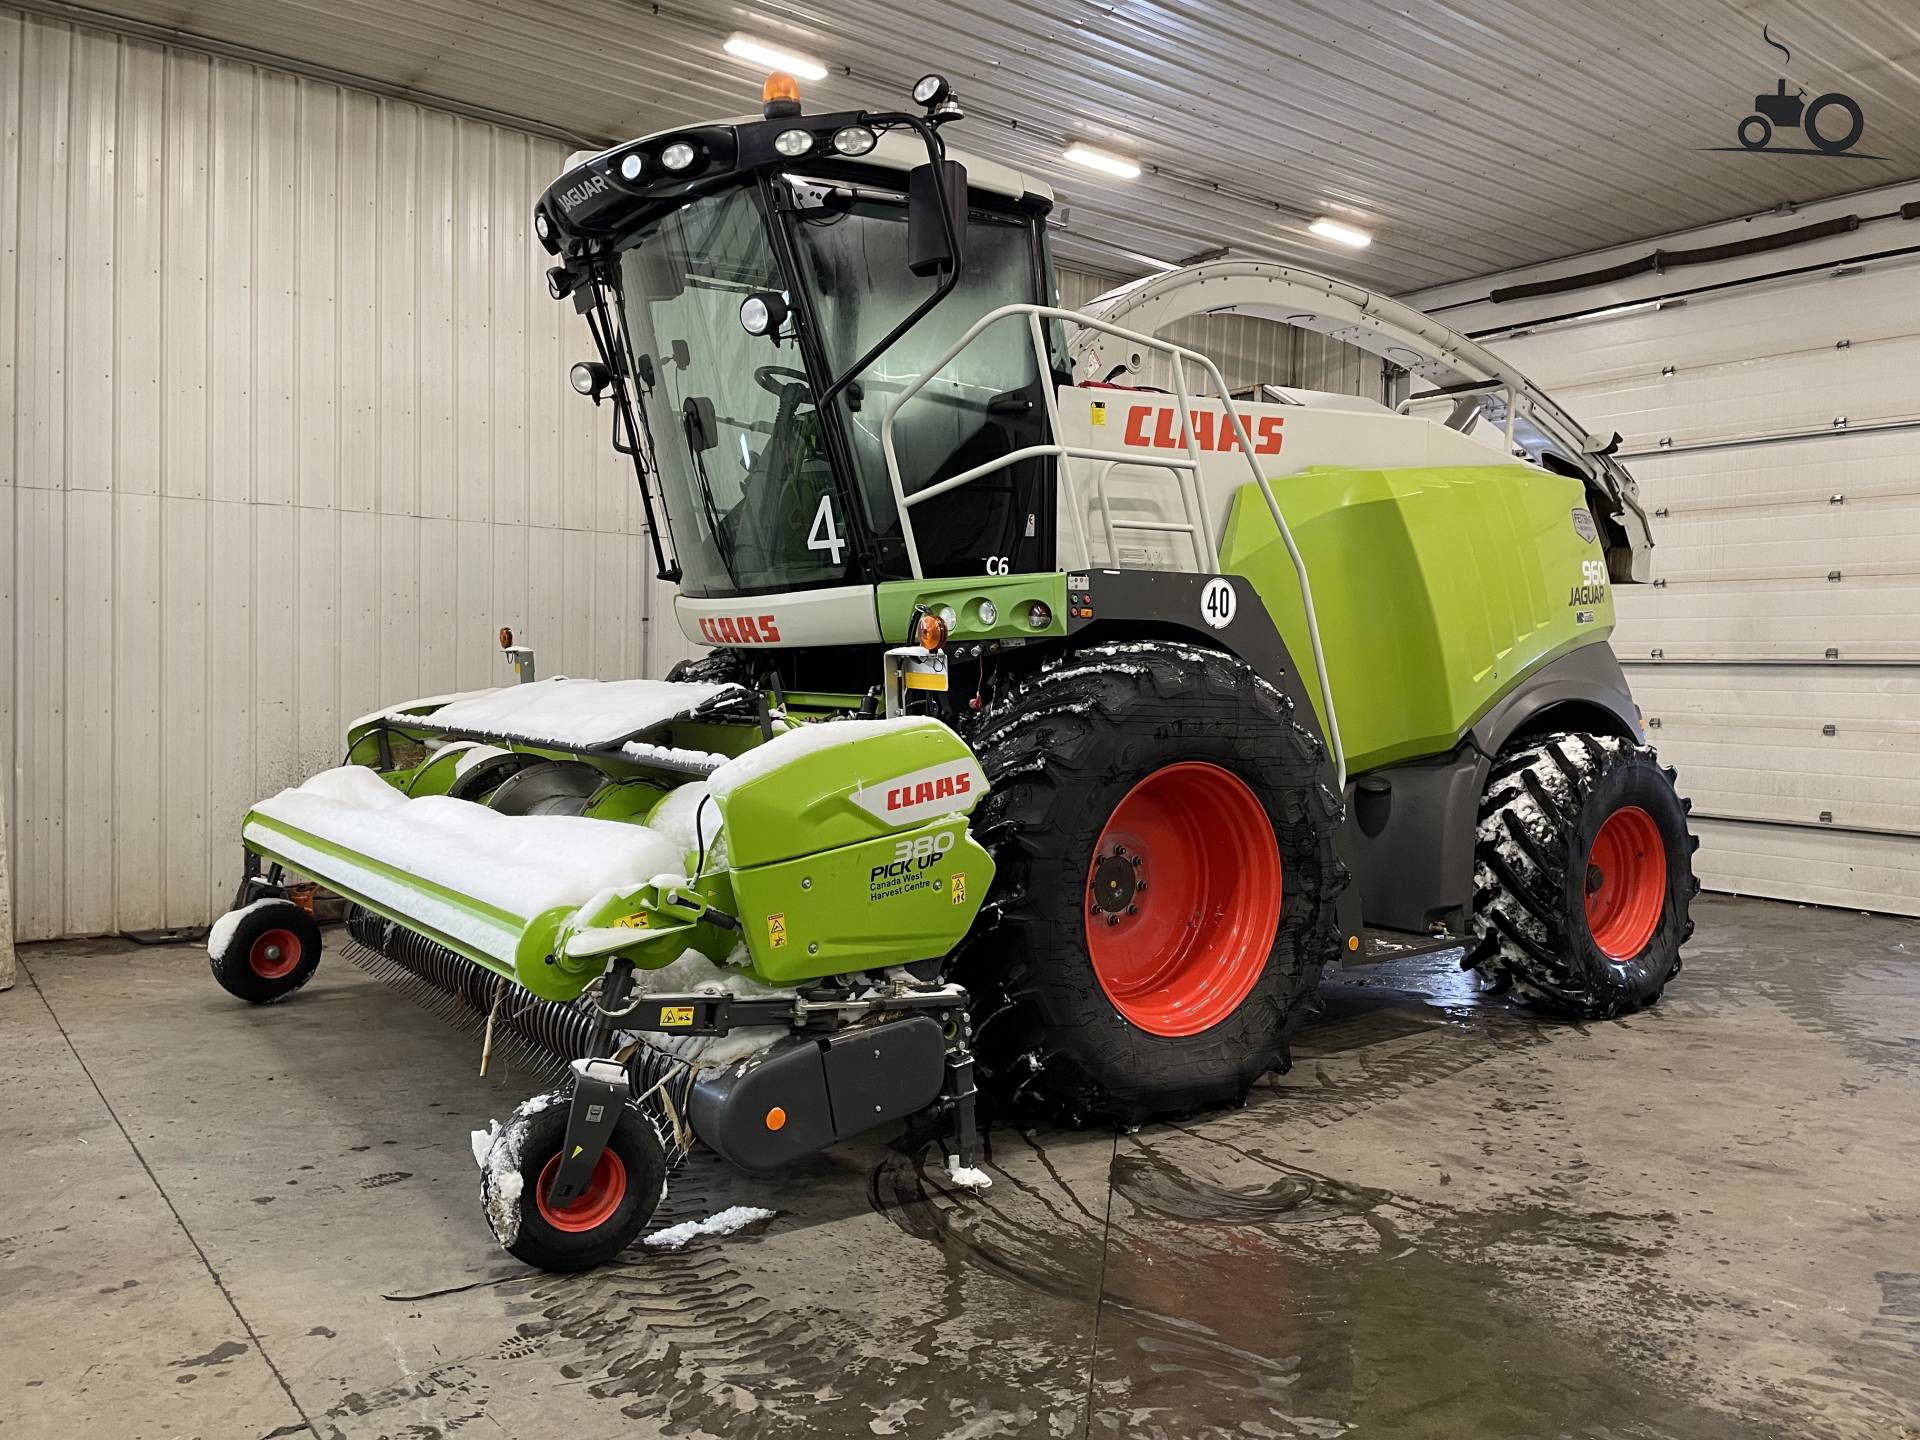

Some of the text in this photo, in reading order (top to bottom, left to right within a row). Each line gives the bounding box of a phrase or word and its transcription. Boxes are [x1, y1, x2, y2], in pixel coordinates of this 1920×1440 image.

[559, 176, 609, 213] JAGUAR
[1124, 405, 1284, 454] CLAAS
[807, 495, 845, 564] 4
[986, 556, 1009, 576] C6
[1582, 560, 1605, 586] 960
[1207, 587, 1230, 618] 40
[1568, 585, 1605, 607] JAGUAR
[699, 615, 781, 643] CLAAS
[887, 772, 971, 811] CLAAS
[893, 831, 955, 863] 380
[870, 852, 943, 882] PICK UP
[870, 871, 923, 892] Canada West
[870, 879, 931, 901] Harvest Centre
